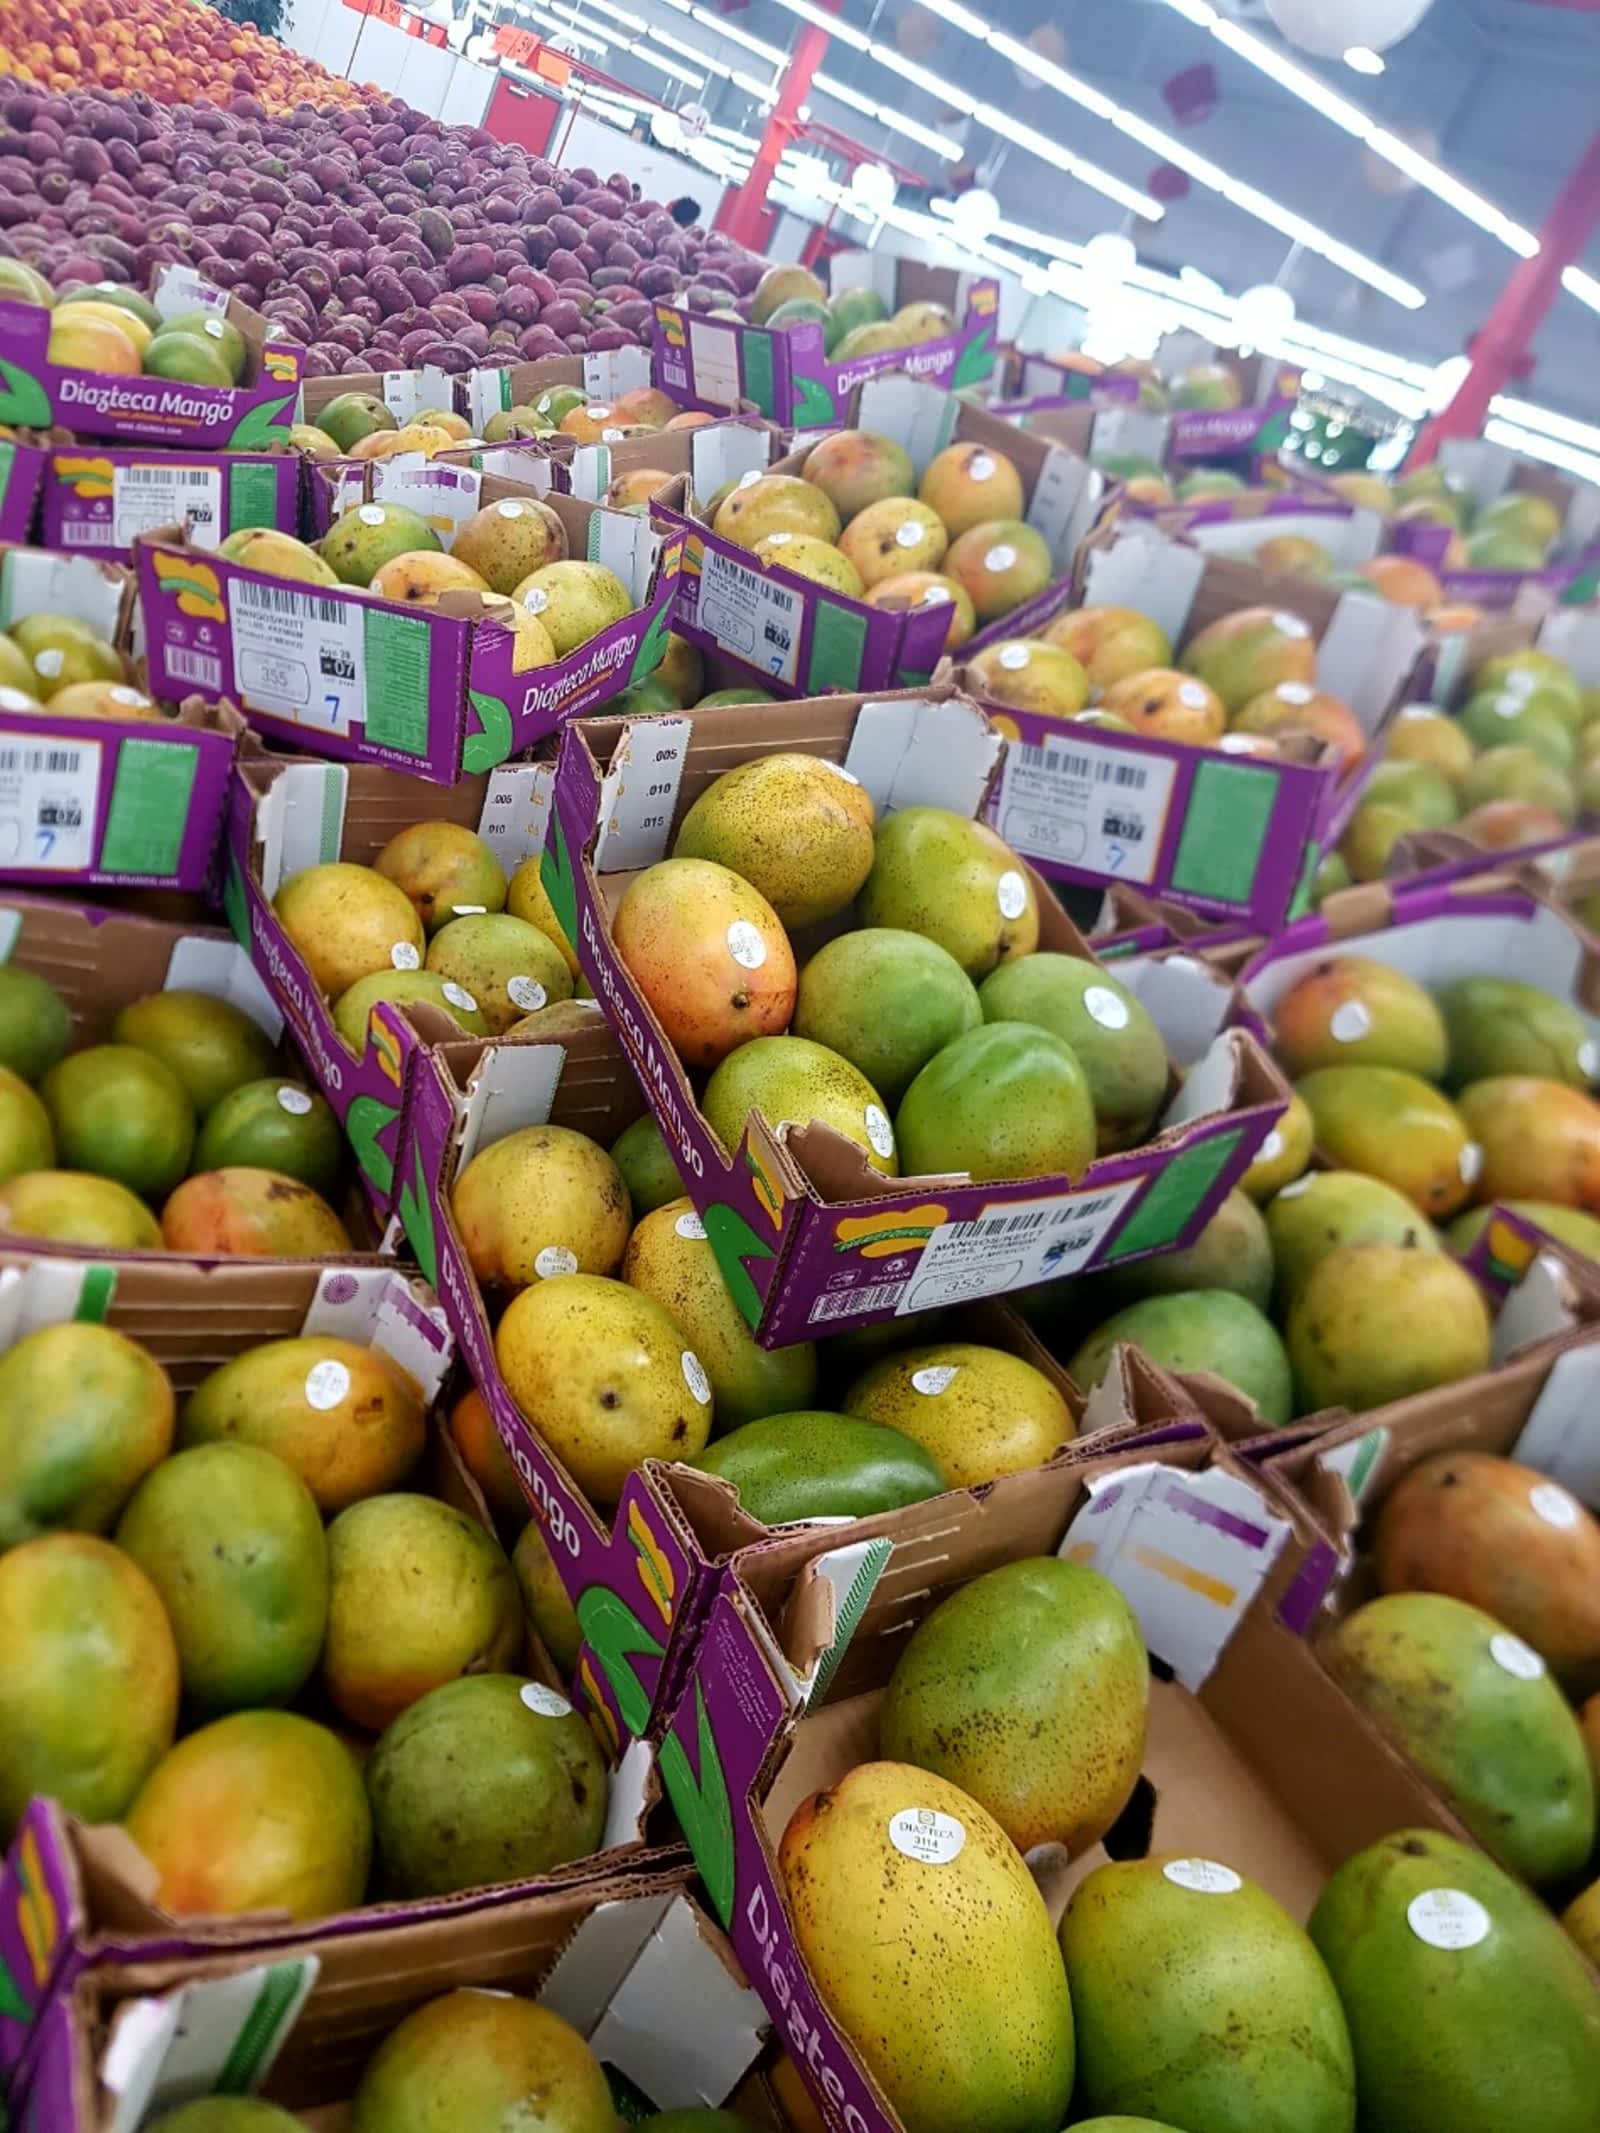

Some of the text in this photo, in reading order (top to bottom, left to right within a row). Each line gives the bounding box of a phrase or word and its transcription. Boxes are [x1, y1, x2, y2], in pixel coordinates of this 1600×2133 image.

[59, 379, 156, 413] Diazteca
[159, 392, 233, 426] Mango
[588, 634, 637, 678] Mango
[261, 664, 288, 687] 355
[334, 659, 354, 678] 07
[324, 694, 340, 724] 7
[653, 749, 677, 763] .005
[646, 783, 671, 797] .010
[640, 816, 664, 829] .015
[1028, 823, 1060, 843] 355
[36, 829, 56, 859] 7
[647, 1042, 704, 1178] Mango
[944, 1277, 985, 1294] 355
[914, 1835, 938, 1849] 3114
